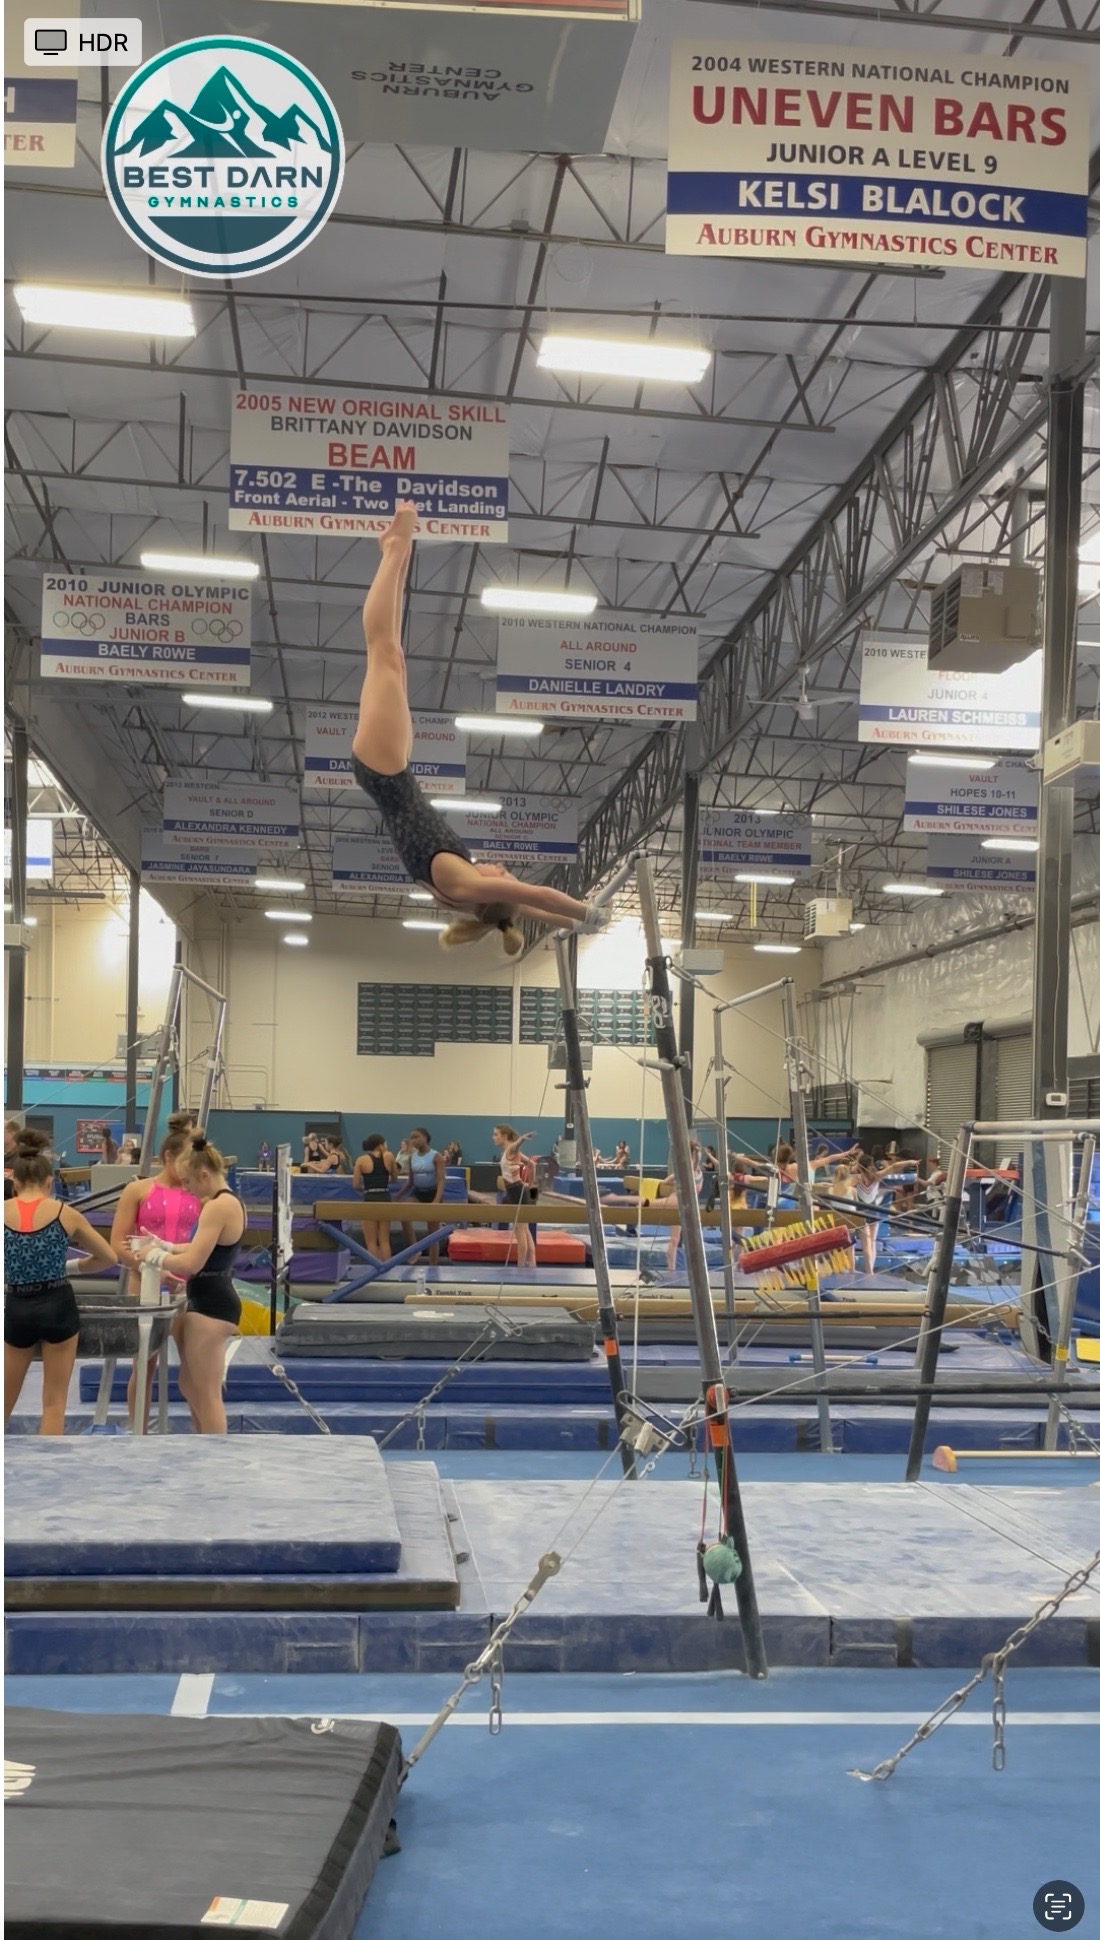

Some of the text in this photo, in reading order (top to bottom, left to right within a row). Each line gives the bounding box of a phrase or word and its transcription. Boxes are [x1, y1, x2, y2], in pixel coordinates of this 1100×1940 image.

[388, 61, 502, 79] CENTER
[691, 56, 1069, 94] 2004 WESTERN NATIONAL CHAMPION
[351, 70, 534, 93] GYMNASTICS
[383, 84, 500, 101] AUBURN
[692, 85, 1067, 146] UNEVEN BARS
[766, 143, 998, 174] JUNIOR A LEVEL 9
[738, 180, 1025, 223] KELSI BLALOCK
[696, 223, 1059, 265] AUBURN GYMNASTICS CENTER
[236, 394, 506, 423] 2005 NEW ORIGINAL SKILL
[270, 416, 472, 440] BRITTANY DAVIDSON
[328, 442, 416, 470] BEAM
[234, 469, 297, 488] 7.502
[311, 473, 325, 490] E
[396, 477, 497, 498] Davidson
[234, 490, 280, 505] Front
[285, 492, 336, 508] Aerial
[352, 496, 389, 510] Two
[395, 498, 432, 512] Fet
[438, 501, 505, 518] Landing
[248, 511, 314, 528] AUBURN
[426, 520, 490, 536] CENTER
[46, 578, 249, 600] 2010 JUNIOR OLYMPIC
[63, 594, 232, 614] NATIONAL CHAMPION
[125, 612, 170, 626] BARS
[501, 618, 697, 635] 2010 WESTERN NATIONAL CHAMPION
[109, 627, 185, 643] JUNIOR B
[98, 644, 148, 658] BAELY
[560, 640, 637, 653] ALL AROUND
[864, 648, 926, 659] 2010 WESTE
[55, 662, 237, 682] AUBURN GYMNASTICS CENTER
[565, 658, 632, 672] SENIOR 4
[529, 679, 665, 696] DANIELLE LANDRY
[927, 688, 977, 700] JUNIOR
[308, 711, 359, 720] 2012 WESTE
[509, 699, 683, 716] AUBURN GYMNASTICS CENTER
[888, 708, 1027, 726] LAUREN SCHMEISS
[316, 726, 456, 742] VAULT AROUND
[872, 727, 918, 740] AUBURN
[969, 775, 998, 783] VAULT
[188, 795, 213, 803] VAULT
[224, 797, 239, 805] ALL
[241, 798, 276, 806] AROUND
[950, 788, 1016, 799] HOPES 10-11
[500, 796, 526, 808] 2013
[209, 808, 254, 818] SENIOR D
[510, 811, 559, 822] OLYMPIC
[937, 804, 1028, 818] SHILESE JONES
[174, 821, 237, 833] ALEXANDRA
[239, 825, 287, 834] KENNEDY
[467, 819, 557, 830] NATIONAL CHAMPION
[1013, 823, 1037, 833] CENT
[745, 828, 794, 839] OLYMPIC
[483, 841, 512, 850] BAELY
[737, 840, 761, 849] TEAM
[763, 841, 801, 850] MEMBER
[953, 869, 1028, 881] SHILESE JONES
